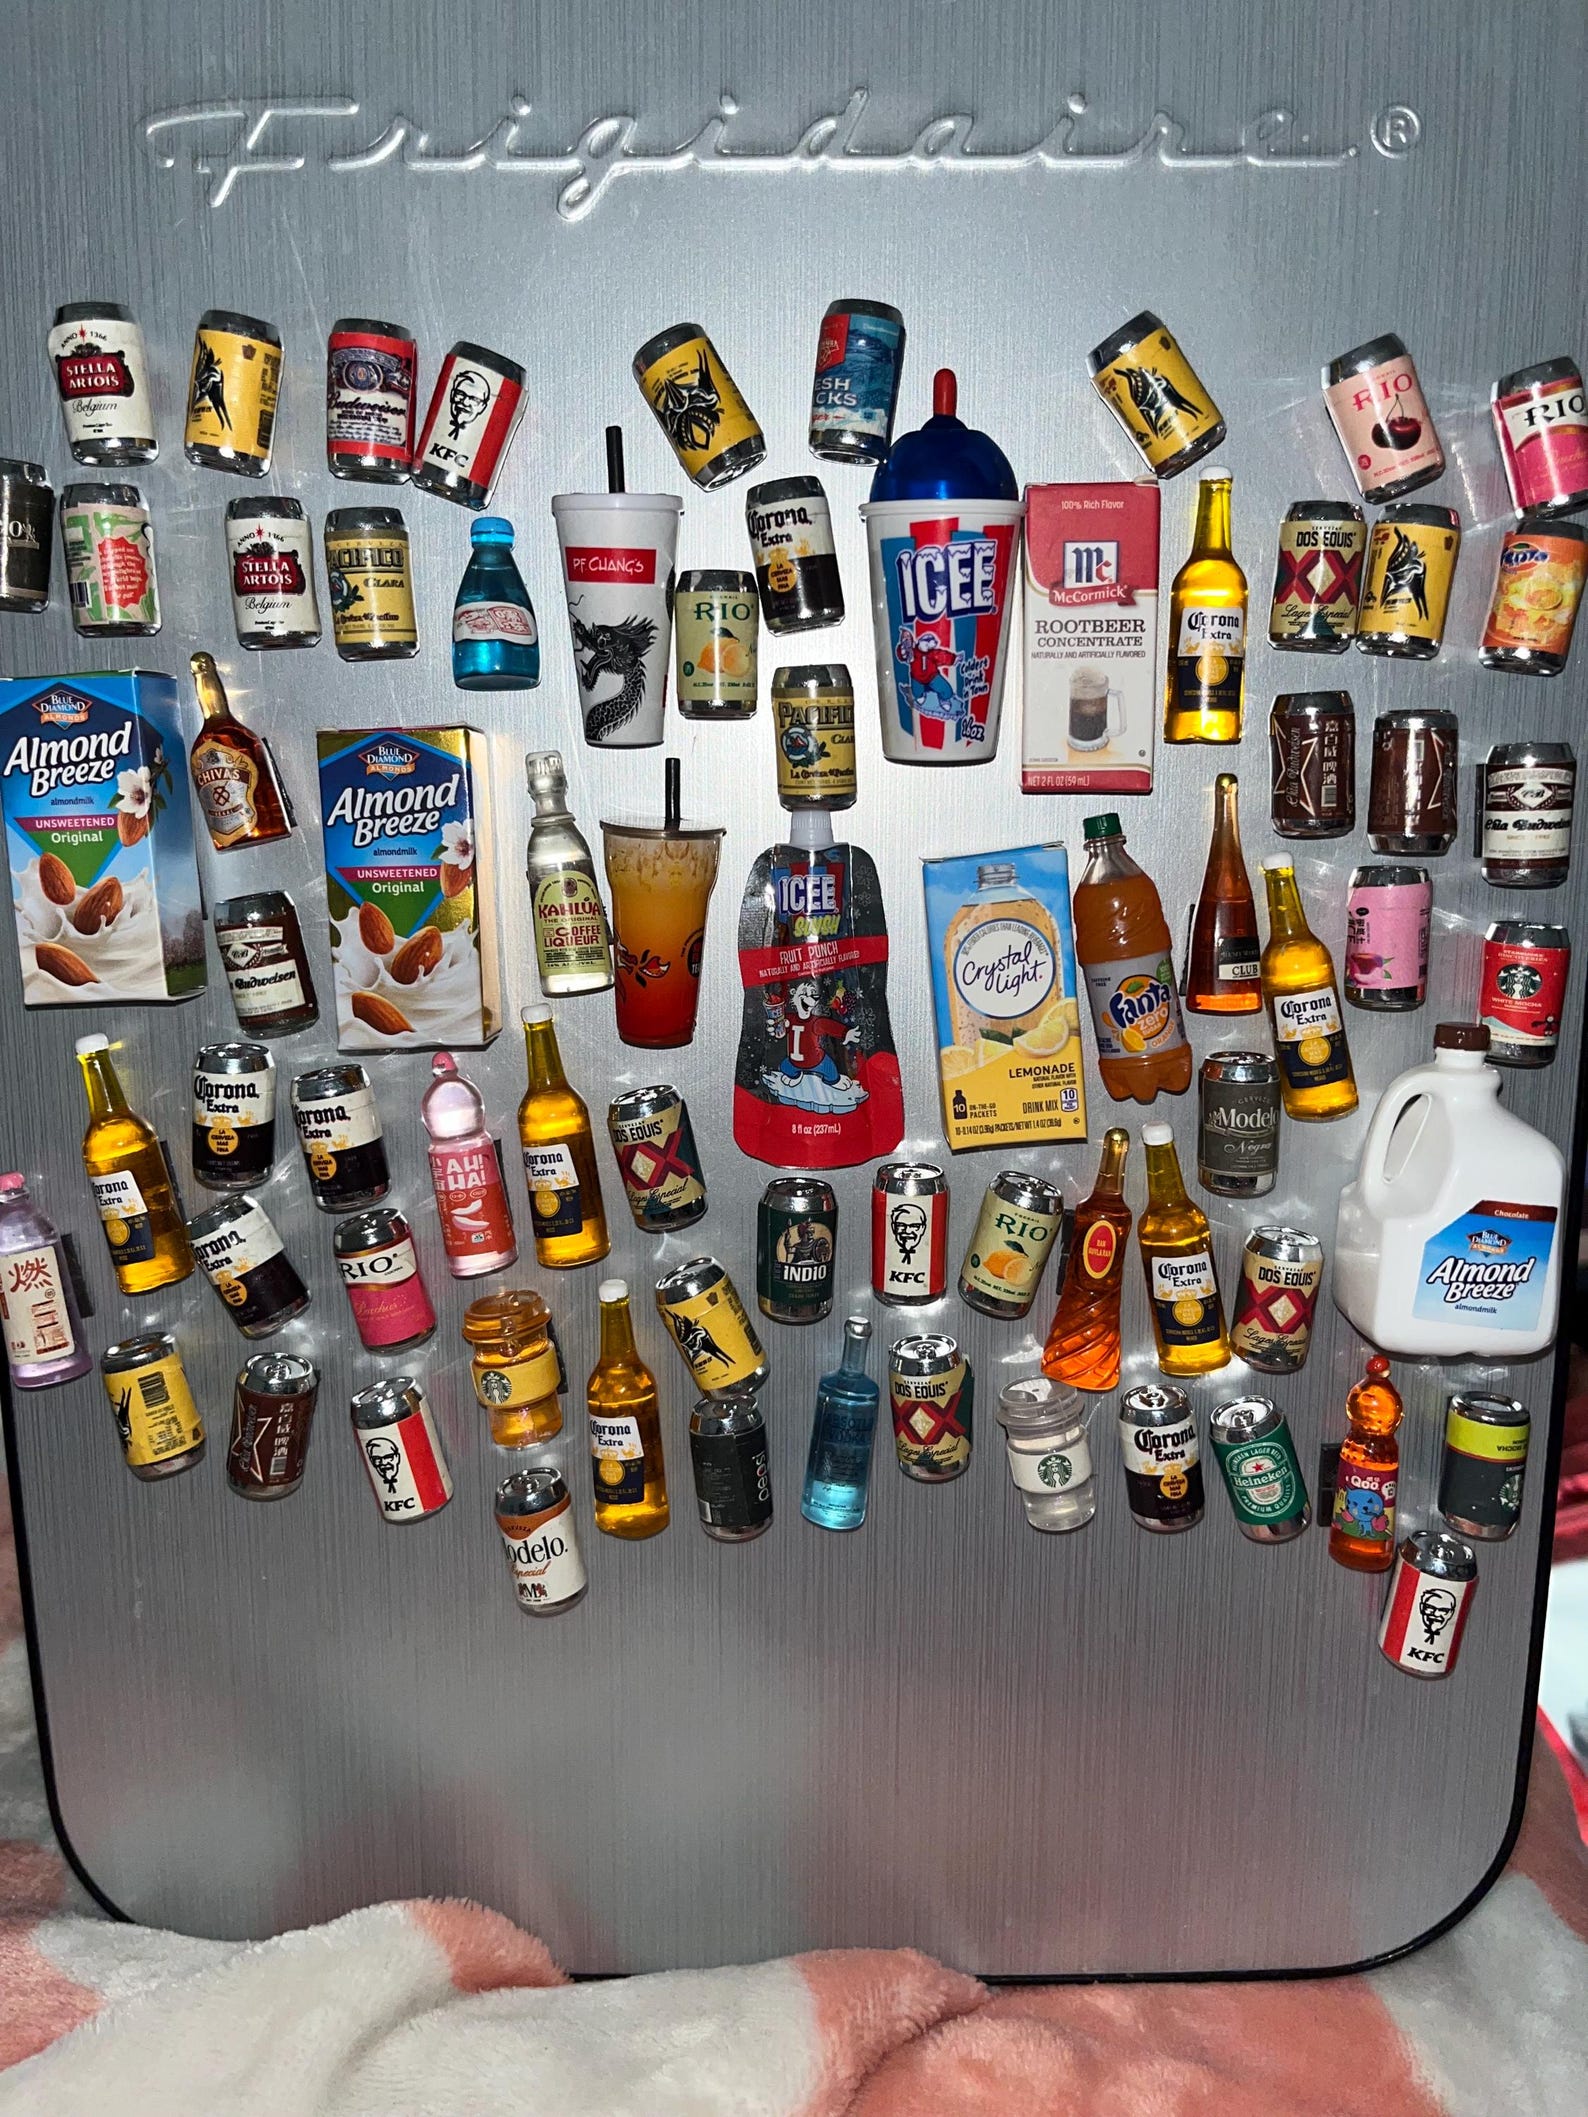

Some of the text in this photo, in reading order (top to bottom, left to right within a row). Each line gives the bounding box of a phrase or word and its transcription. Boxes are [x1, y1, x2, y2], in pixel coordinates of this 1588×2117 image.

[66, 362, 116, 377] STELLA
[69, 375, 120, 390] ARTOIS
[1352, 373, 1413, 412] RIO
[72, 399, 118, 417] Belgium
[327, 388, 407, 417] Budweiser
[1523, 393, 1586, 427] RIO
[429, 443, 470, 468] KFC
[1061, 500, 1125, 510] 100% Rich Flavor
[748, 507, 813, 539] Corona
[237, 532, 256, 549] ANNO
[761, 532, 793, 548] Extra
[1296, 531, 1354, 548] DOS EQUIS
[242, 560, 290, 573] STELLA
[327, 548, 405, 570] PACIFICO
[588, 556, 645, 576] CHANG'S
[243, 573, 293, 586] ARTOIS
[363, 578, 405, 589] CLARA
[896, 540, 999, 625] ICEE
[1053, 584, 1128, 604] McCormick
[245, 597, 293, 614] Belgium
[694, 602, 751, 622] RIO
[1034, 619, 1146, 635] ROOTBEER
[1187, 611, 1240, 633] Corona
[1037, 636, 1144, 648] CONCENTRATE
[1031, 650, 1146, 660] NATURALLY AND ARTIFICIALLY FLAVORED
[960, 656, 989, 677] Coldest
[964, 672, 985, 689] Drink
[51, 694, 73, 704] BLUE
[969, 683, 989, 699] Town
[40, 701, 86, 713] DIAMOND
[3, 720, 133, 777] Almond
[378, 746, 400, 756] BLUE
[367, 752, 413, 764] DIAMOND
[30, 758, 115, 797] Breeze
[197, 768, 240, 786] CHIVAS
[370, 764, 412, 774] ALMONDS
[1027, 776, 1041, 787] NET
[1047, 776, 1055, 787] FL
[1055, 776, 1065, 787] OZ
[50, 797, 95, 806] almondmilk
[326, 773, 460, 826] Almond
[35, 817, 115, 829] UNSWEETENED
[353, 810, 440, 847] Breeze
[50, 830, 104, 846] Original
[373, 847, 418, 856] almondmilk
[357, 867, 438, 879] UNSWEETENED
[371, 880, 425, 896] Original
[778, 874, 837, 914] ICEE
[538, 897, 601, 920] KAHLÚA
[555, 924, 601, 937] COFFEE
[793, 914, 841, 938] SLUSH
[544, 935, 600, 948] LIQUEUR
[779, 940, 839, 965] FRUIT PUNCH
[758, 965, 788, 978] NATURALLY
[962, 940, 1032, 991] Crystal
[1231, 963, 1258, 976] CLUB
[1109, 982, 1172, 1029] Fanta
[1280, 996, 1333, 1019] Corona
[1137, 1006, 1169, 1031] zero
[1296, 1014, 1328, 1026] Extra
[1151, 1018, 1176, 1049] ORANGE
[790, 1025, 804, 1062] I
[1008, 1062, 1075, 1079] LEMONADE
[1032, 1074, 1051, 1082] NATURAL
[1050, 1073, 1066, 1081] FLAVOR
[193, 1074, 260, 1103] Corona
[1063, 1089, 1075, 1100] 10
[206, 1098, 240, 1113] Extra
[953, 1103, 966, 1113] 10
[969, 1102, 996, 1111] ON-THE-GO
[1022, 1099, 1059, 1114] DRINK MIX
[969, 1110, 998, 1119] PACKETS
[1218, 1106, 1279, 1129] Modelo
[302, 1125, 333, 1139] Extra
[630, 1119, 663, 1142] EQUIS
[791, 1123, 797, 1134] 8
[803, 1125, 813, 1135] oz
[813, 1123, 842, 1136] (237mL)
[1223, 1139, 1272, 1156] Negra
[446, 1154, 485, 1175] AH!
[522, 1151, 564, 1168] Corona
[530, 1165, 557, 1178] Extra
[448, 1170, 487, 1191] HA!
[99, 1194, 123, 1206] Extra
[1494, 1208, 1530, 1219] Chocolate
[994, 1213, 1048, 1242] RIO
[1481, 1230, 1499, 1240] BLUE
[1471, 1236, 1507, 1247] DIAMOND
[203, 1256, 233, 1272] Extra
[340, 1256, 393, 1280] RIO
[1157, 1261, 1208, 1280] Corona
[1427, 1257, 1536, 1283] Almond
[8, 1257, 53, 1293] 燃
[783, 1264, 827, 1282] INDIO
[888, 1270, 926, 1284] KFC
[1258, 1266, 1315, 1287] DOS EQUIS
[1172, 1276, 1202, 1289] Extra
[1444, 1282, 1516, 1302] Breeze
[1454, 1303, 1498, 1314] almondmilk
[894, 1381, 947, 1399] DOS EQUIS
[590, 1418, 632, 1437] Corona
[597, 1434, 624, 1447] Extra
[1134, 1424, 1197, 1455] Corona
[1154, 1449, 1186, 1462] Extra
[1250, 1447, 1271, 1456] LAGER
[1234, 1466, 1288, 1487] Heineken
[1350, 1475, 1379, 1490] Qoo
[383, 1497, 415, 1512] KFC
[1241, 1495, 1273, 1512] PREMIUM
[1407, 1646, 1445, 1664] KFC
